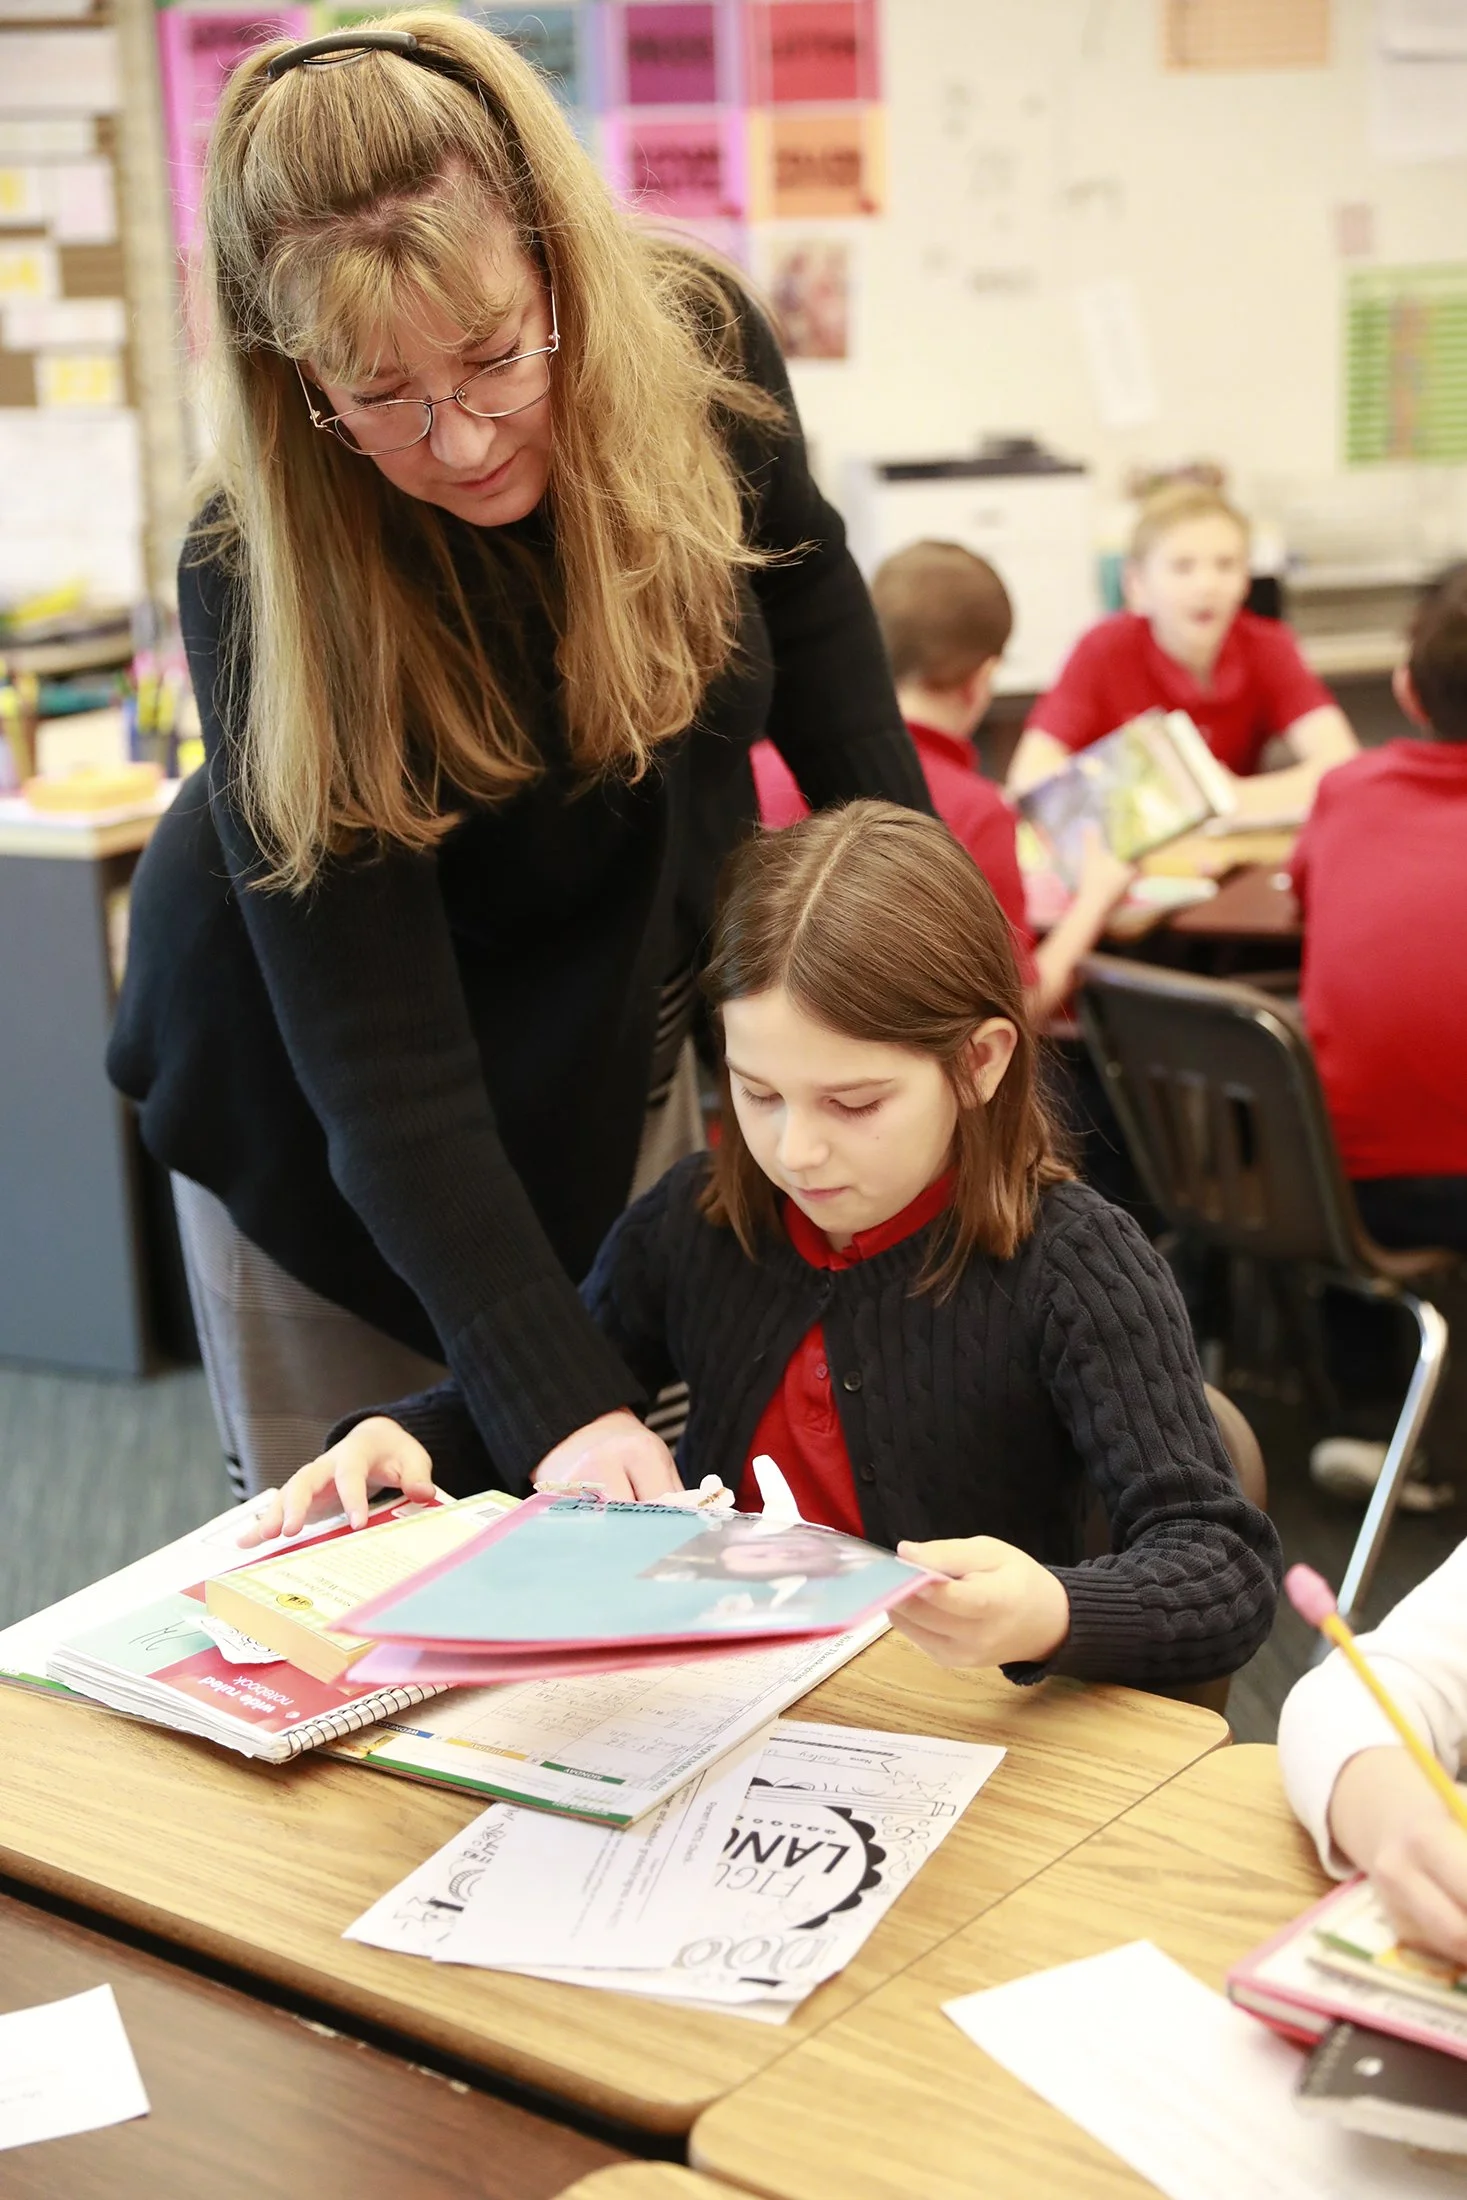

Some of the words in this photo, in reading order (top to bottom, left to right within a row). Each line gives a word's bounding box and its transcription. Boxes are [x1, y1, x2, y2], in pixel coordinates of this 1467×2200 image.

[197, 1675, 242, 1697] ruled
[232, 1675, 295, 1706] notebook
[240, 1694, 277, 1713] wide
[671, 1743, 718, 1778] NOVEMBER
[562, 1767, 605, 1781] MONDAY
